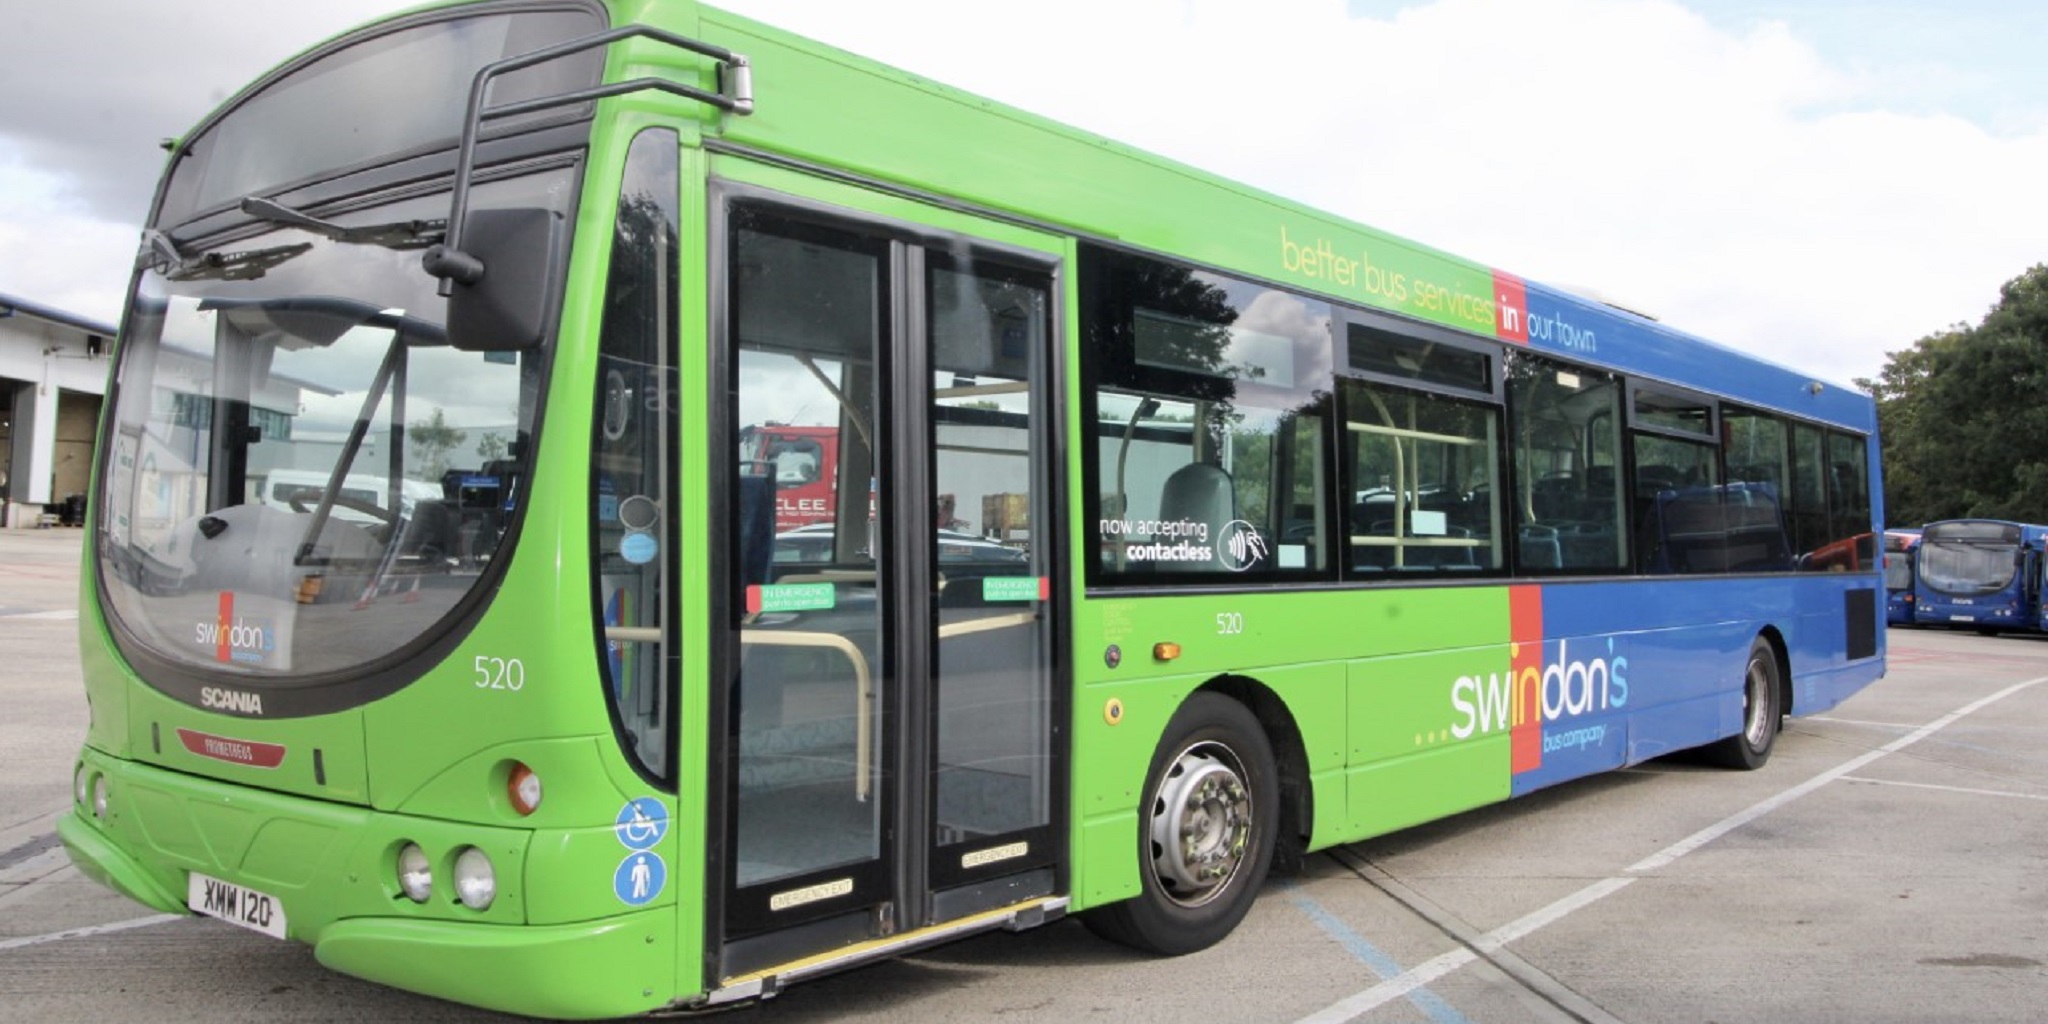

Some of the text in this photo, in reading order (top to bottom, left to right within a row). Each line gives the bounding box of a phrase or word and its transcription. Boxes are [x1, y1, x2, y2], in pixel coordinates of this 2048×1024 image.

[1281, 225, 1597, 353] better bus services in our town
[1099, 517, 1208, 542] now accepting
[1126, 540, 1213, 562] contactless
[1216, 612, 1243, 635] 520
[475, 655, 524, 691] 520
[1450, 637, 1629, 740] swindon's
[201, 686, 263, 715] SCANIA
[1543, 723, 1608, 754] bus company
[204, 878, 270, 928] XMW 120
